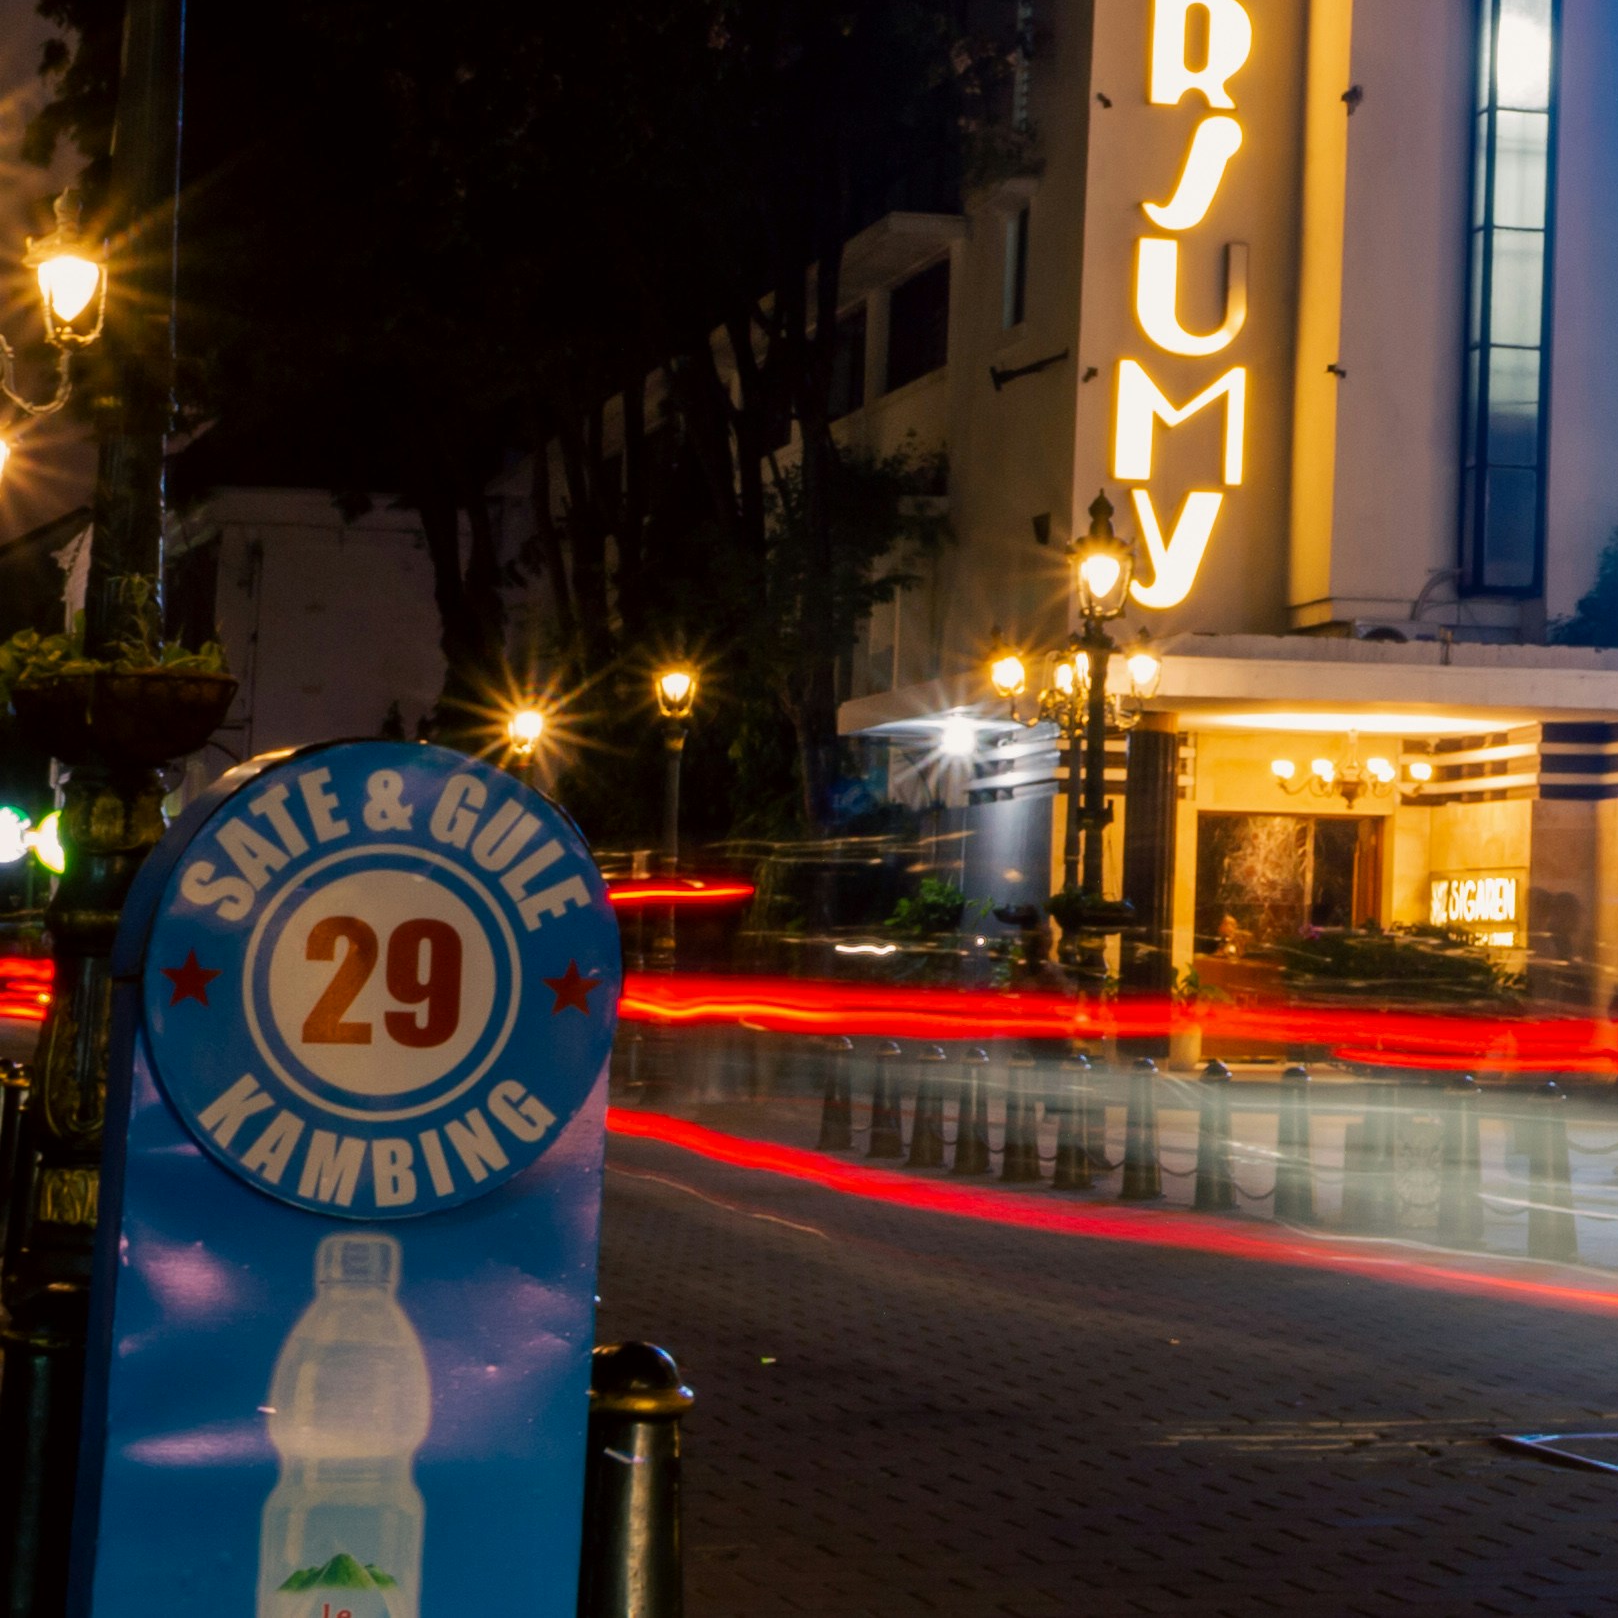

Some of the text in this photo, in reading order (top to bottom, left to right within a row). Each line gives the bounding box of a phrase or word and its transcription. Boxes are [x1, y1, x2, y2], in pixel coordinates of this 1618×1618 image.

[180, 766, 592, 932] SATE & GULE
[301, 915, 463, 1049] 29
[197, 1072, 558, 1208] KAMBING
